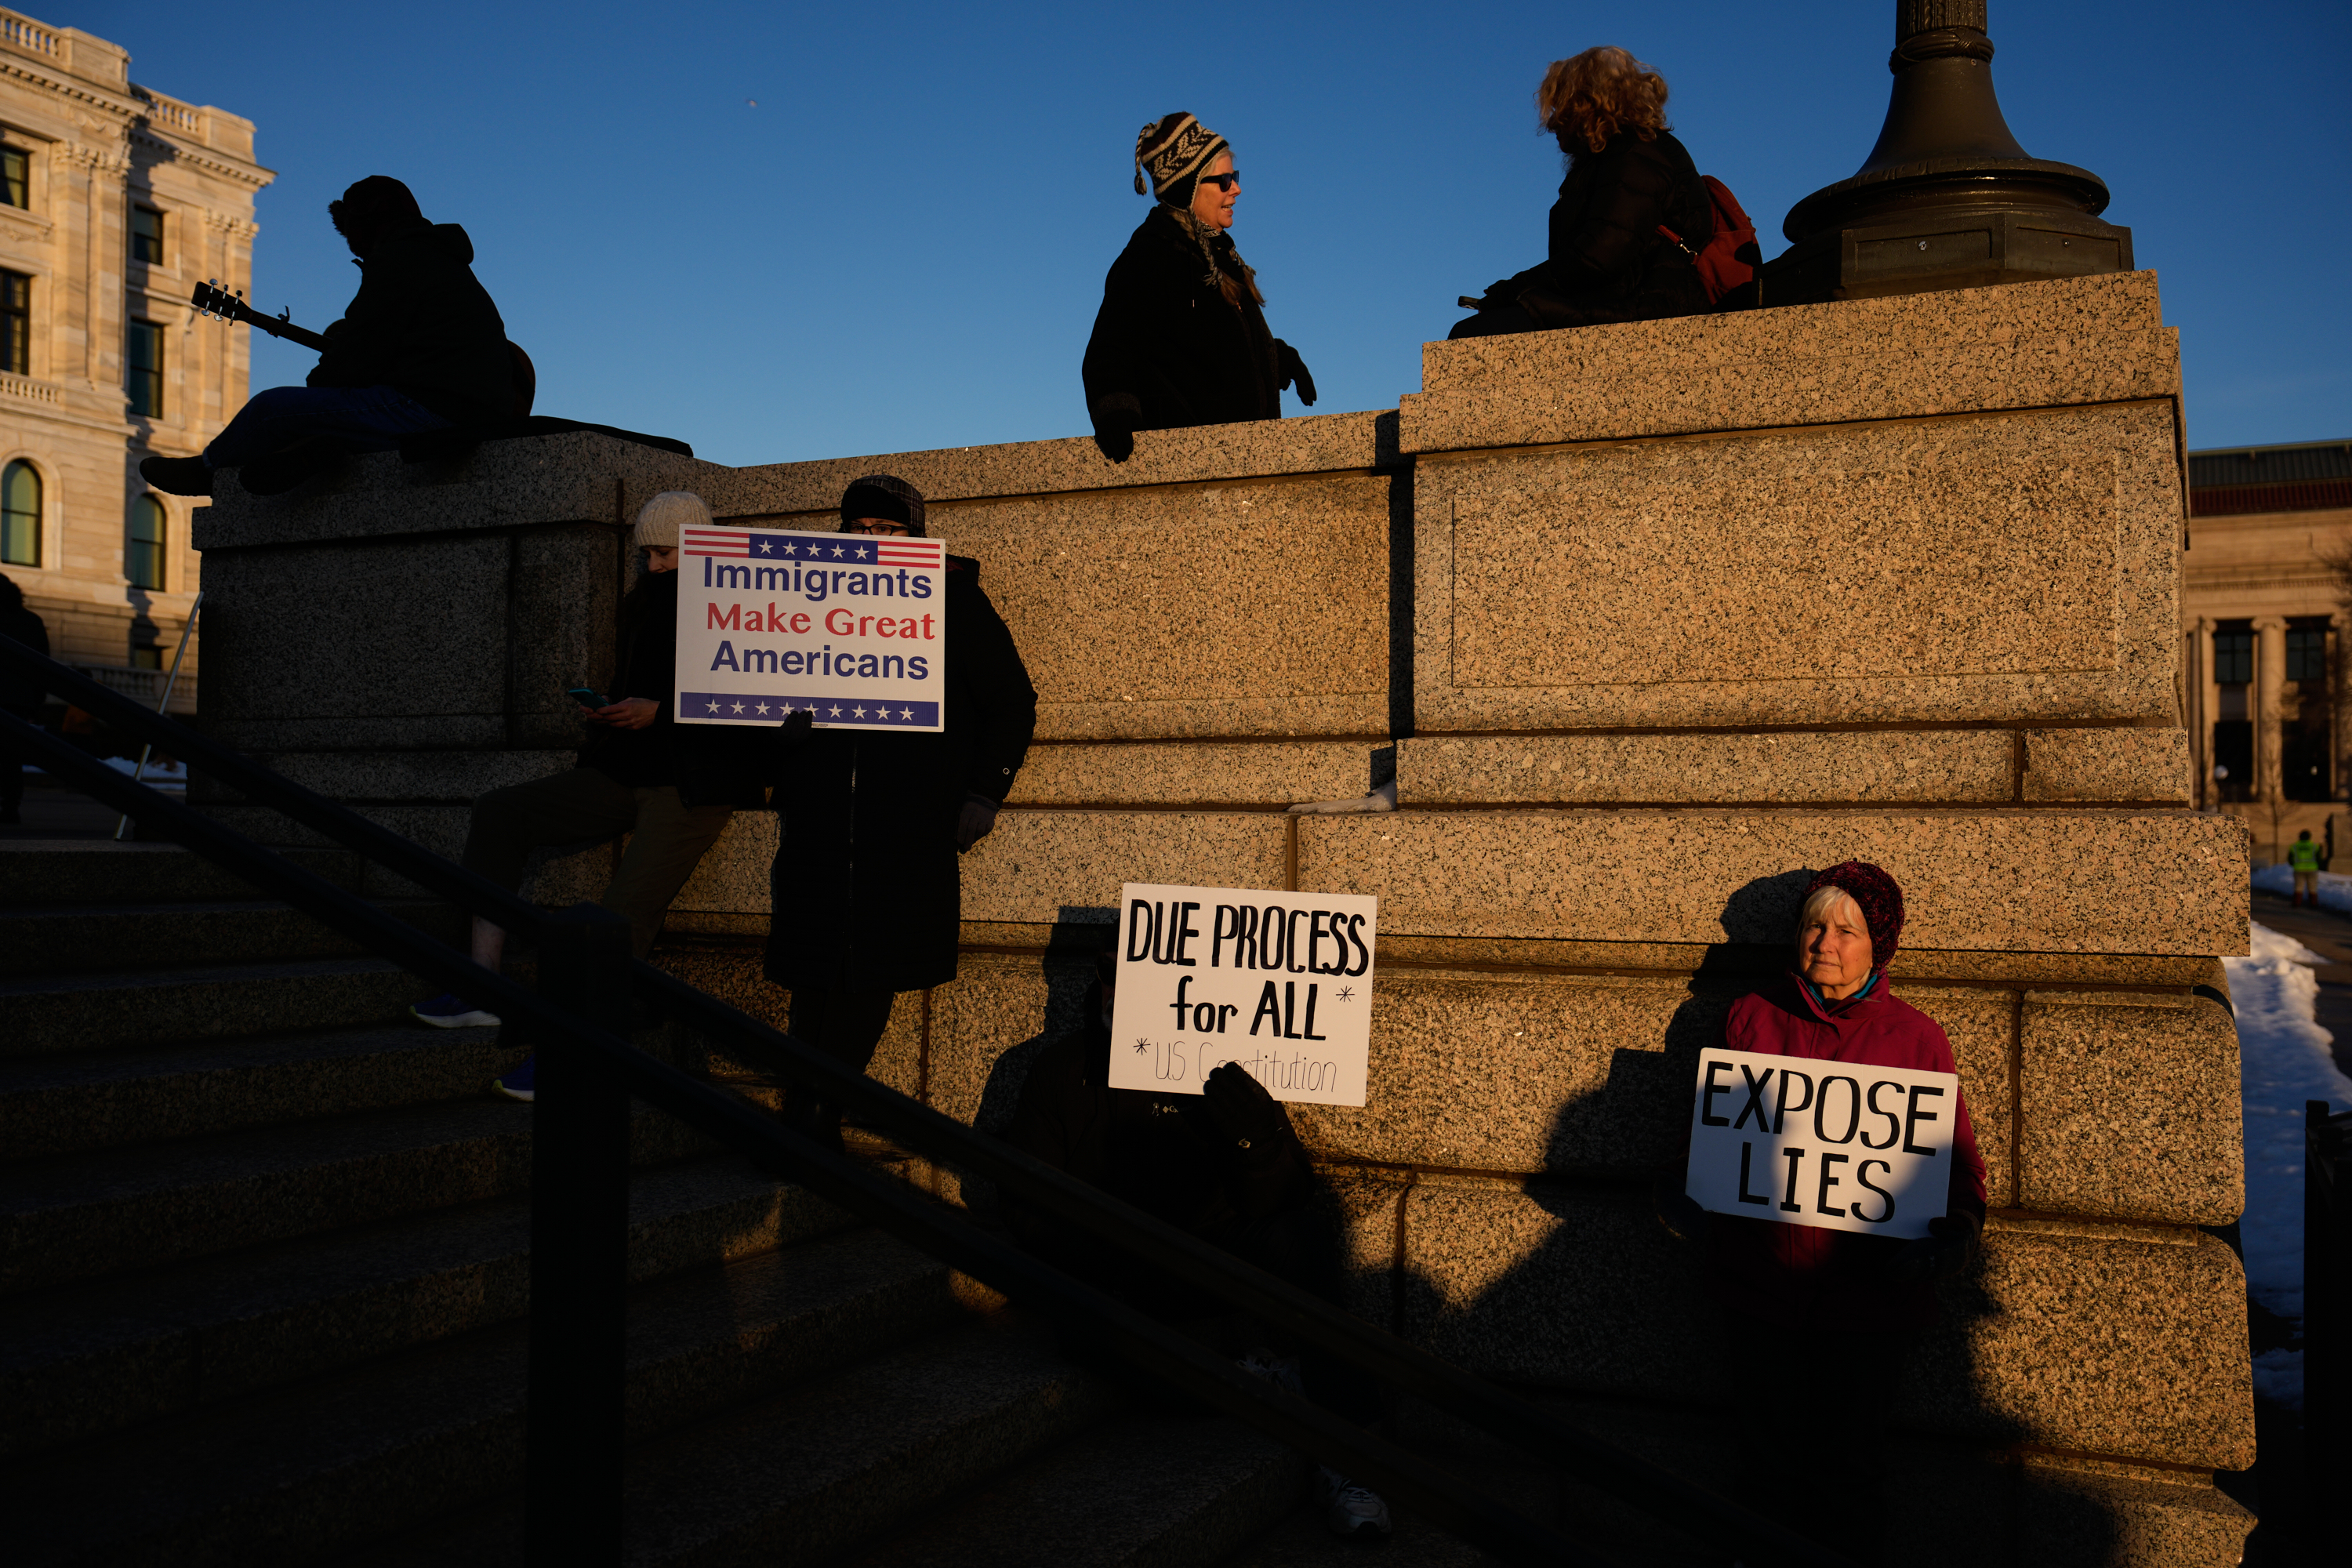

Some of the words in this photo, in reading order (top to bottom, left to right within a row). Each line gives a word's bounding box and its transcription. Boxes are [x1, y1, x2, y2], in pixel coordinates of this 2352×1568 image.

[704, 557, 932, 602] Immigrants
[707, 601, 811, 634] Make
[825, 608, 936, 640] Great
[710, 640, 929, 681] Americans
[1126, 898, 1200, 967] DUE
[1211, 904, 1369, 977] PROCESS
[1169, 975, 1239, 1033] for
[1199, 1042, 1337, 1093] Ctitution
[1701, 1061, 1944, 1156] EXPOSE
[1738, 1141, 1896, 1223] LIES
